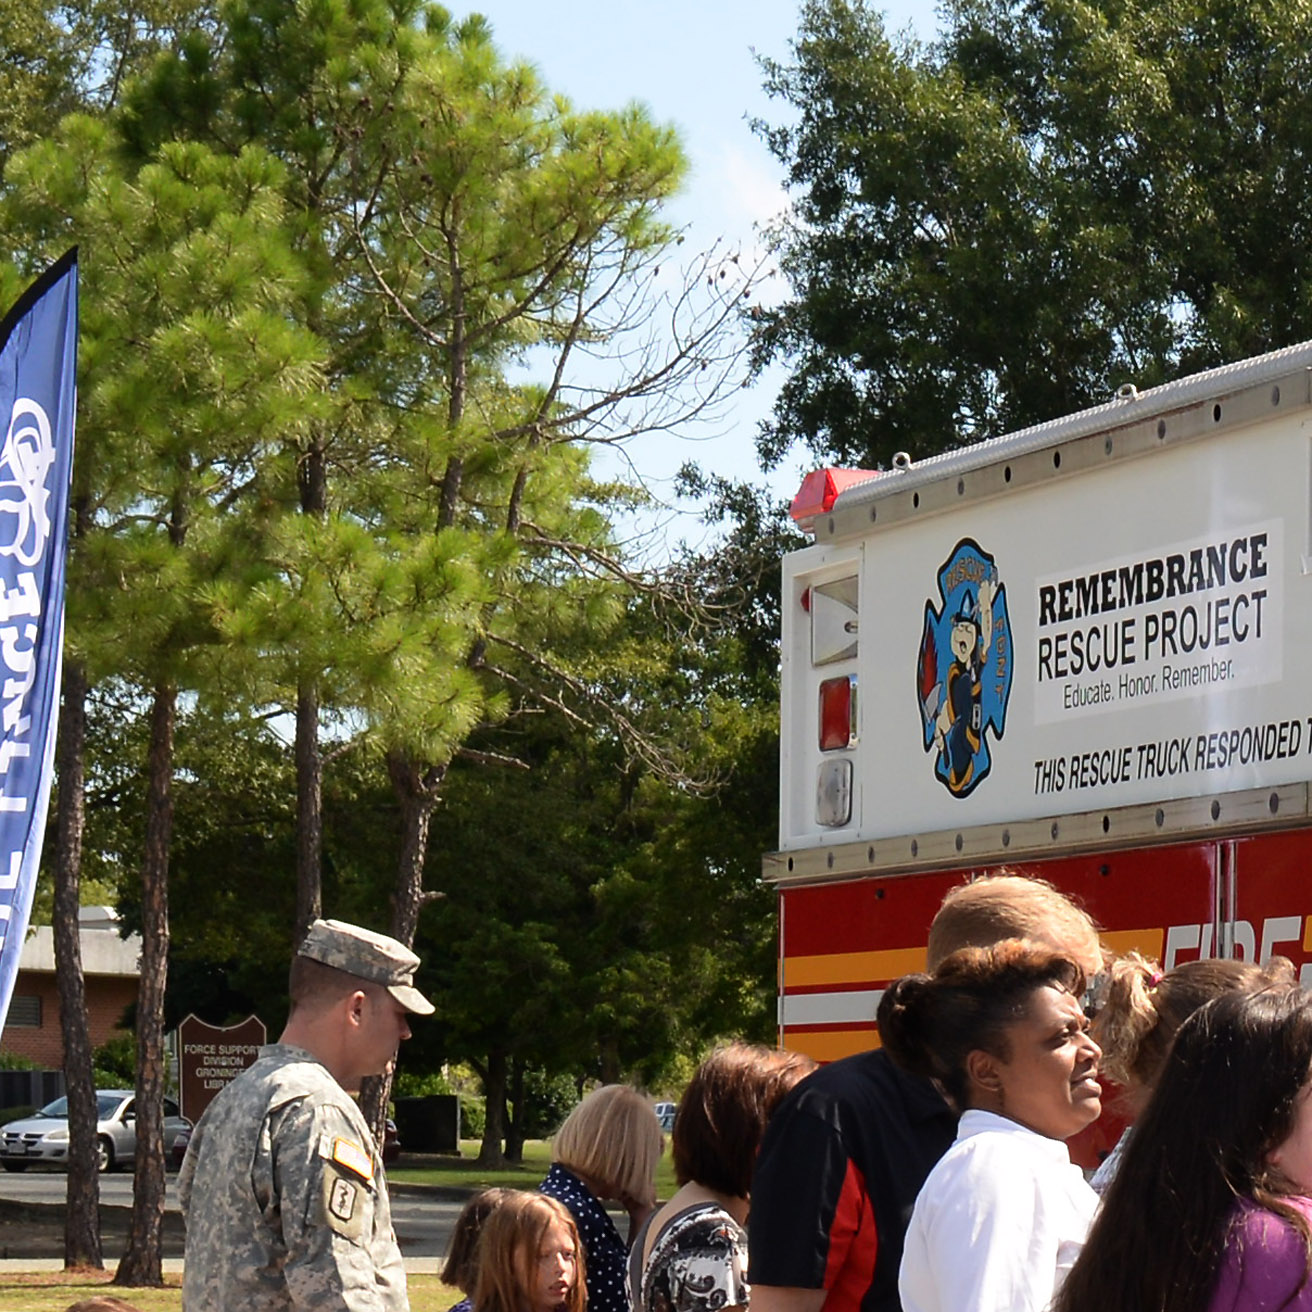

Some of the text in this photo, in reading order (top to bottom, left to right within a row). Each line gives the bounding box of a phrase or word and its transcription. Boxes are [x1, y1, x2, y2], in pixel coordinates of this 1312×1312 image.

[1038, 533, 1268, 627] REMEMBRANCE
[1038, 590, 1268, 682] RESCUE PROJECT
[1063, 657, 1235, 710] Educate. Honor. Remember.
[1033, 756, 1066, 795] THIS
[1068, 749, 1131, 789] RESCUE
[1136, 736, 1192, 778] TRUCK
[1193, 720, 1302, 774] RESPONDED
[184, 1044, 216, 1054] FORCE
[203, 1056, 244, 1066] DIVISION
